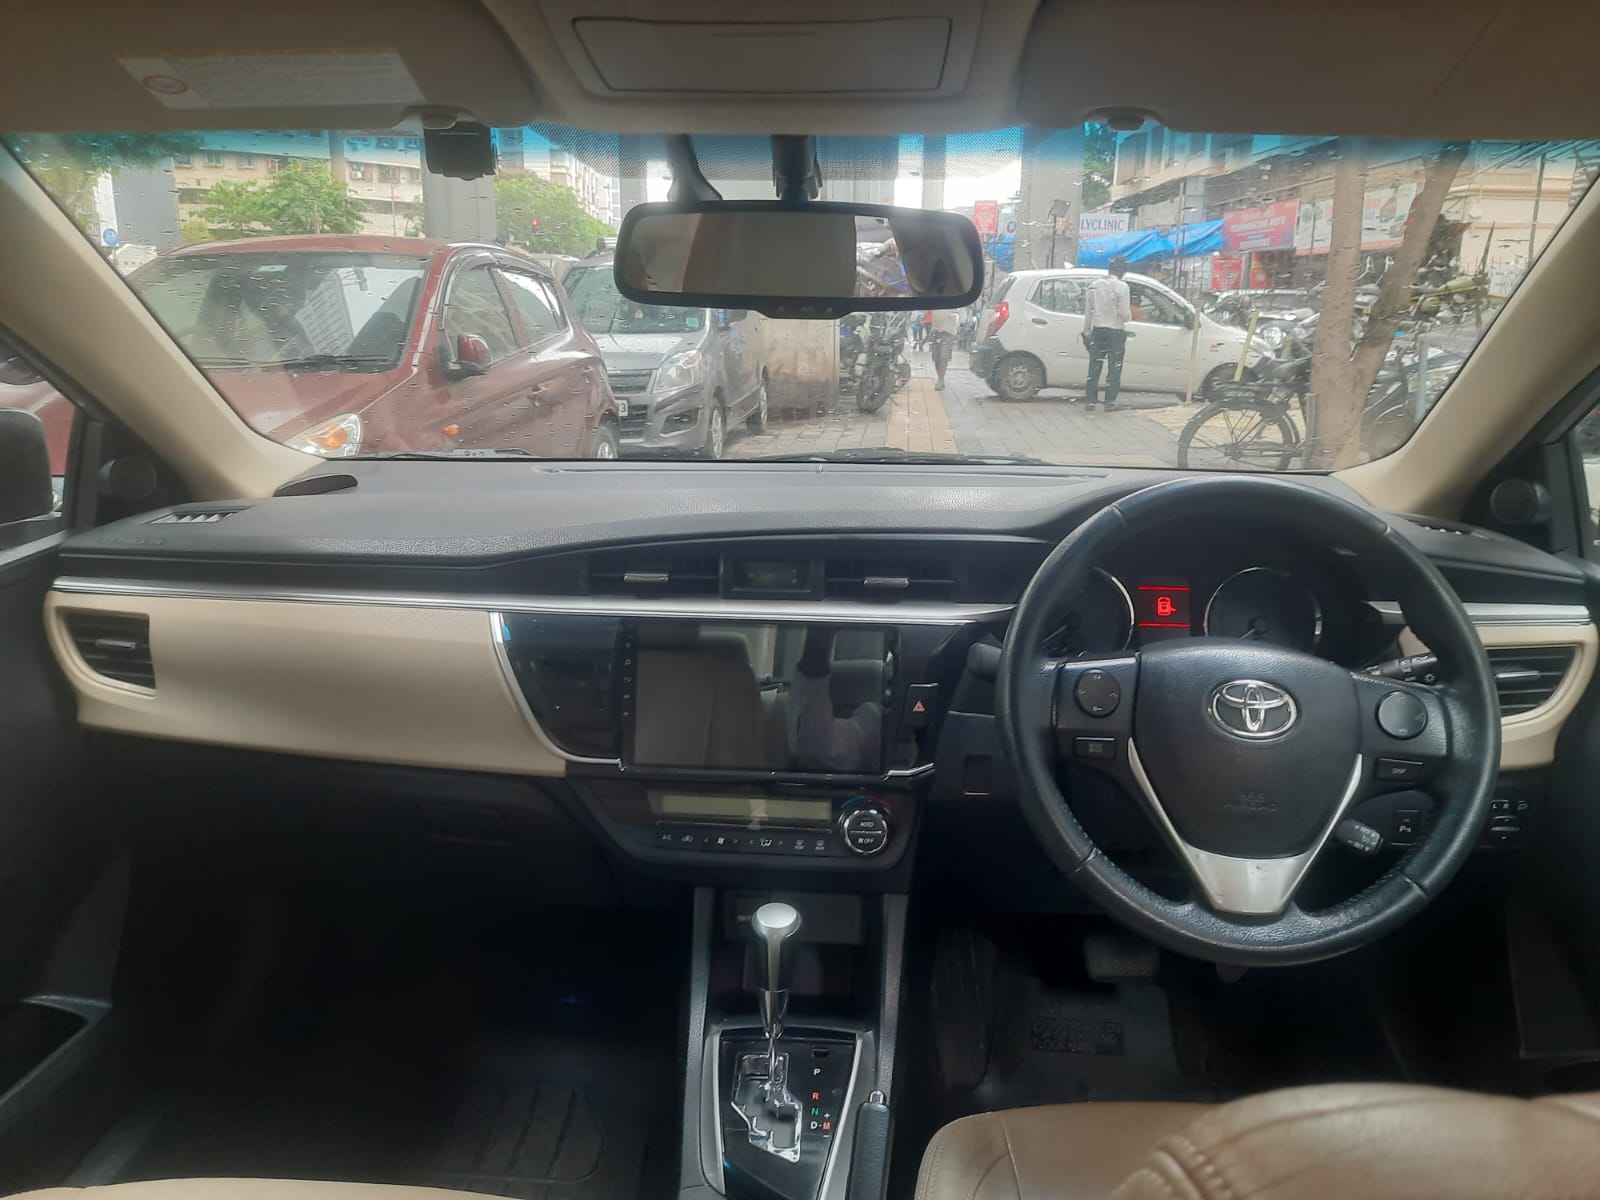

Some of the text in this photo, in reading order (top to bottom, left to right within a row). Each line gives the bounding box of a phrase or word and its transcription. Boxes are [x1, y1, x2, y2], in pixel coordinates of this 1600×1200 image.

[813, 1068, 821, 1076] P
[812, 1091, 820, 1100] R
[811, 1107, 819, 1116] N
